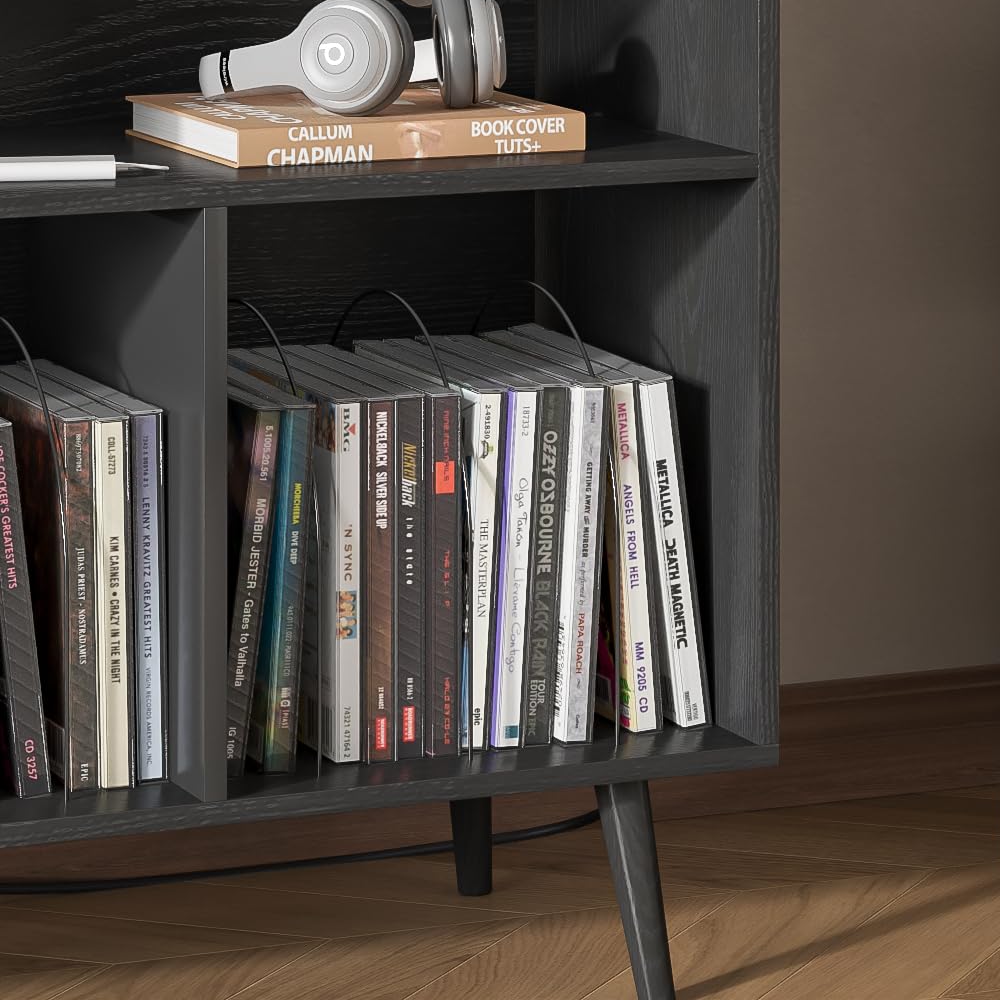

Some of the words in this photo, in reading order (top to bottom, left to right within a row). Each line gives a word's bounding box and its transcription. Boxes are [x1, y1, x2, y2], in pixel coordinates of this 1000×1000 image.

[288, 125, 352, 142] CALLUM
[471, 120, 513, 137] BOOK
[516, 118, 565, 134] COVER
[267, 144, 373, 167] CHAPMAN
[495, 139, 541, 154] TUTS+
[521, 406, 530, 436] 18733-2
[617, 403, 630, 460] METALLICA
[376, 411, 388, 467] NICKELBACK
[107, 437, 116, 475] COLL-57273
[259, 425, 273, 481] 5.1005.20.561
[542, 430, 558, 477] OZZY
[376, 472, 388, 498] SILVER
[401, 442, 417, 507] Nickelback
[585, 462, 593, 492] GETTING
[0, 466, 9, 513] COCKER'S
[514, 478, 528, 509] Olga
[655, 459, 674, 528] METALLICA
[142, 497, 151, 530] LENNY
[291, 483, 302, 525] MORCHEEBA
[376, 500, 387, 518] SIDE
[623, 484, 635, 525] ANGELS
[252, 498, 266, 543] MORBID
[376, 519, 387, 529] UP
[480, 519, 489, 541] THE
[537, 478, 556, 575] OSBOURNE
[2, 516, 15, 563] GREATEST
[110, 537, 119, 551] KIM
[291, 531, 299, 546] DIVE
[581, 527, 589, 558] MURDER
[627, 531, 638, 560] FROM
[75, 547, 85, 571] JUDAS
[142, 535, 151, 577] KRAVITZ
[246, 546, 261, 589] JESTER
[289, 548, 298, 564] DEEP
[344, 544, 353, 582] SYNC
[665, 538, 680, 580] DEATH
[7, 568, 17, 589] HITS
[109, 556, 119, 588] CARNES
[477, 544, 488, 618] MASTERPLAN
[629, 567, 639, 589] HELL
[77, 574, 86, 600] PRIEST
[110, 600, 120, 625] CRAZY
[143, 582, 152, 631] GREATEST
[241, 600, 254, 630] Gates
[534, 580, 551, 632] BLACK
[669, 583, 688, 649] MAGNETIC
[78, 609, 87, 664] NOSTRADAMUS
[111, 629, 120, 638] IN
[240, 633, 249, 643] to
[577, 613, 585, 638] PAPA
[111, 641, 120, 656] THE
[144, 636, 152, 658] HITS
[575, 640, 584, 674] ROACH
[635, 642, 645, 661] MM
[111, 660, 120, 684] NIGHT
[234, 646, 248, 687] Valhalla
[637, 666, 647, 691] 9205
[529, 680, 538, 716] EDITION
[537, 679, 546, 704] TOUR
[639, 697, 648, 713] CD
[343, 706, 351, 728] 74321
[471, 708, 482, 726] epic
[228, 727, 237, 736] IG
[343, 730, 351, 751] 47164
[24, 739, 34, 753] CD
[26, 756, 38, 780] 3257
[81, 763, 89, 781] EPIC
